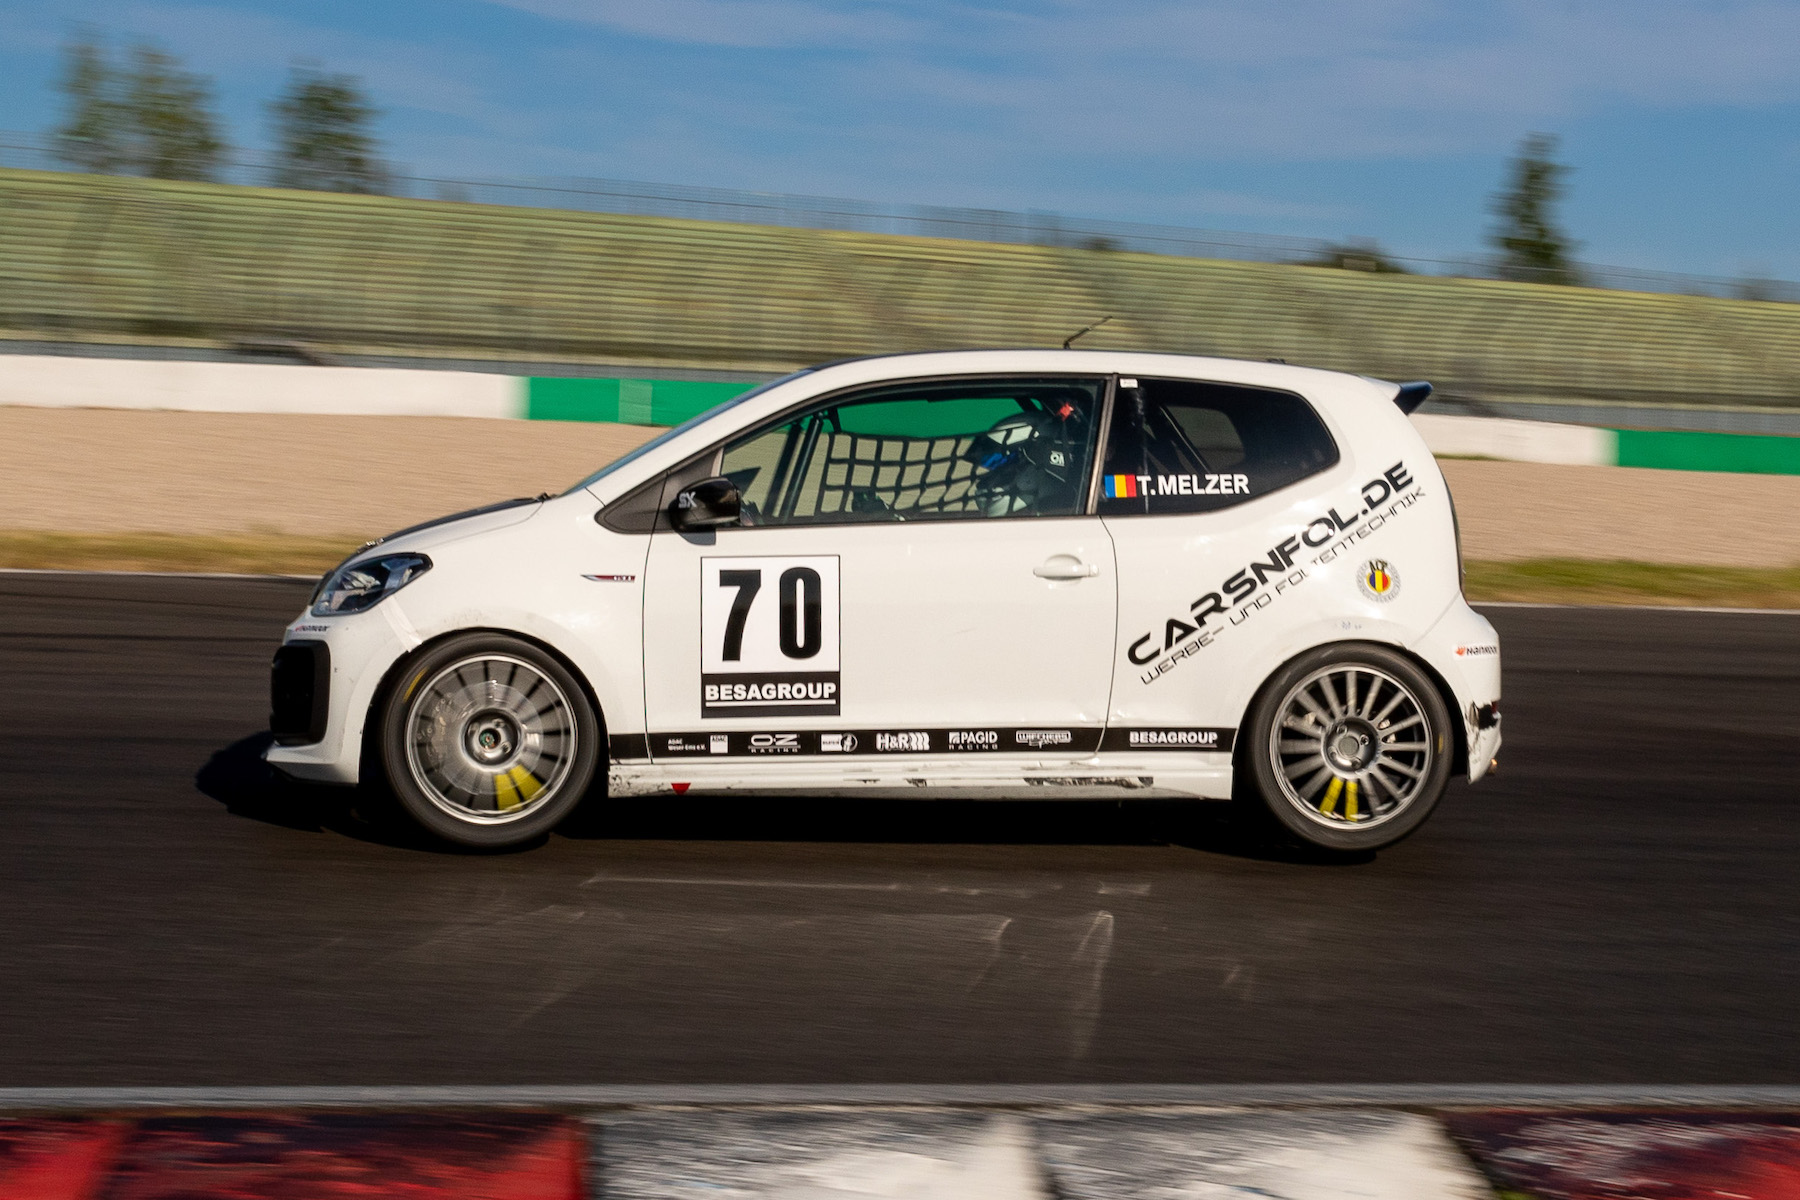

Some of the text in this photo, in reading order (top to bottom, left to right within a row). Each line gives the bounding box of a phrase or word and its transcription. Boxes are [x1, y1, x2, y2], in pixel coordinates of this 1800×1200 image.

[1128, 461, 1413, 665] CARSNFOL.DE
[719, 567, 821, 661] 70
[1229, 593, 1272, 626] UND
[705, 682, 836, 700] BESAGROUP
[961, 731, 998, 744] PAGID
[1129, 731, 1218, 743] BESAGROUP
